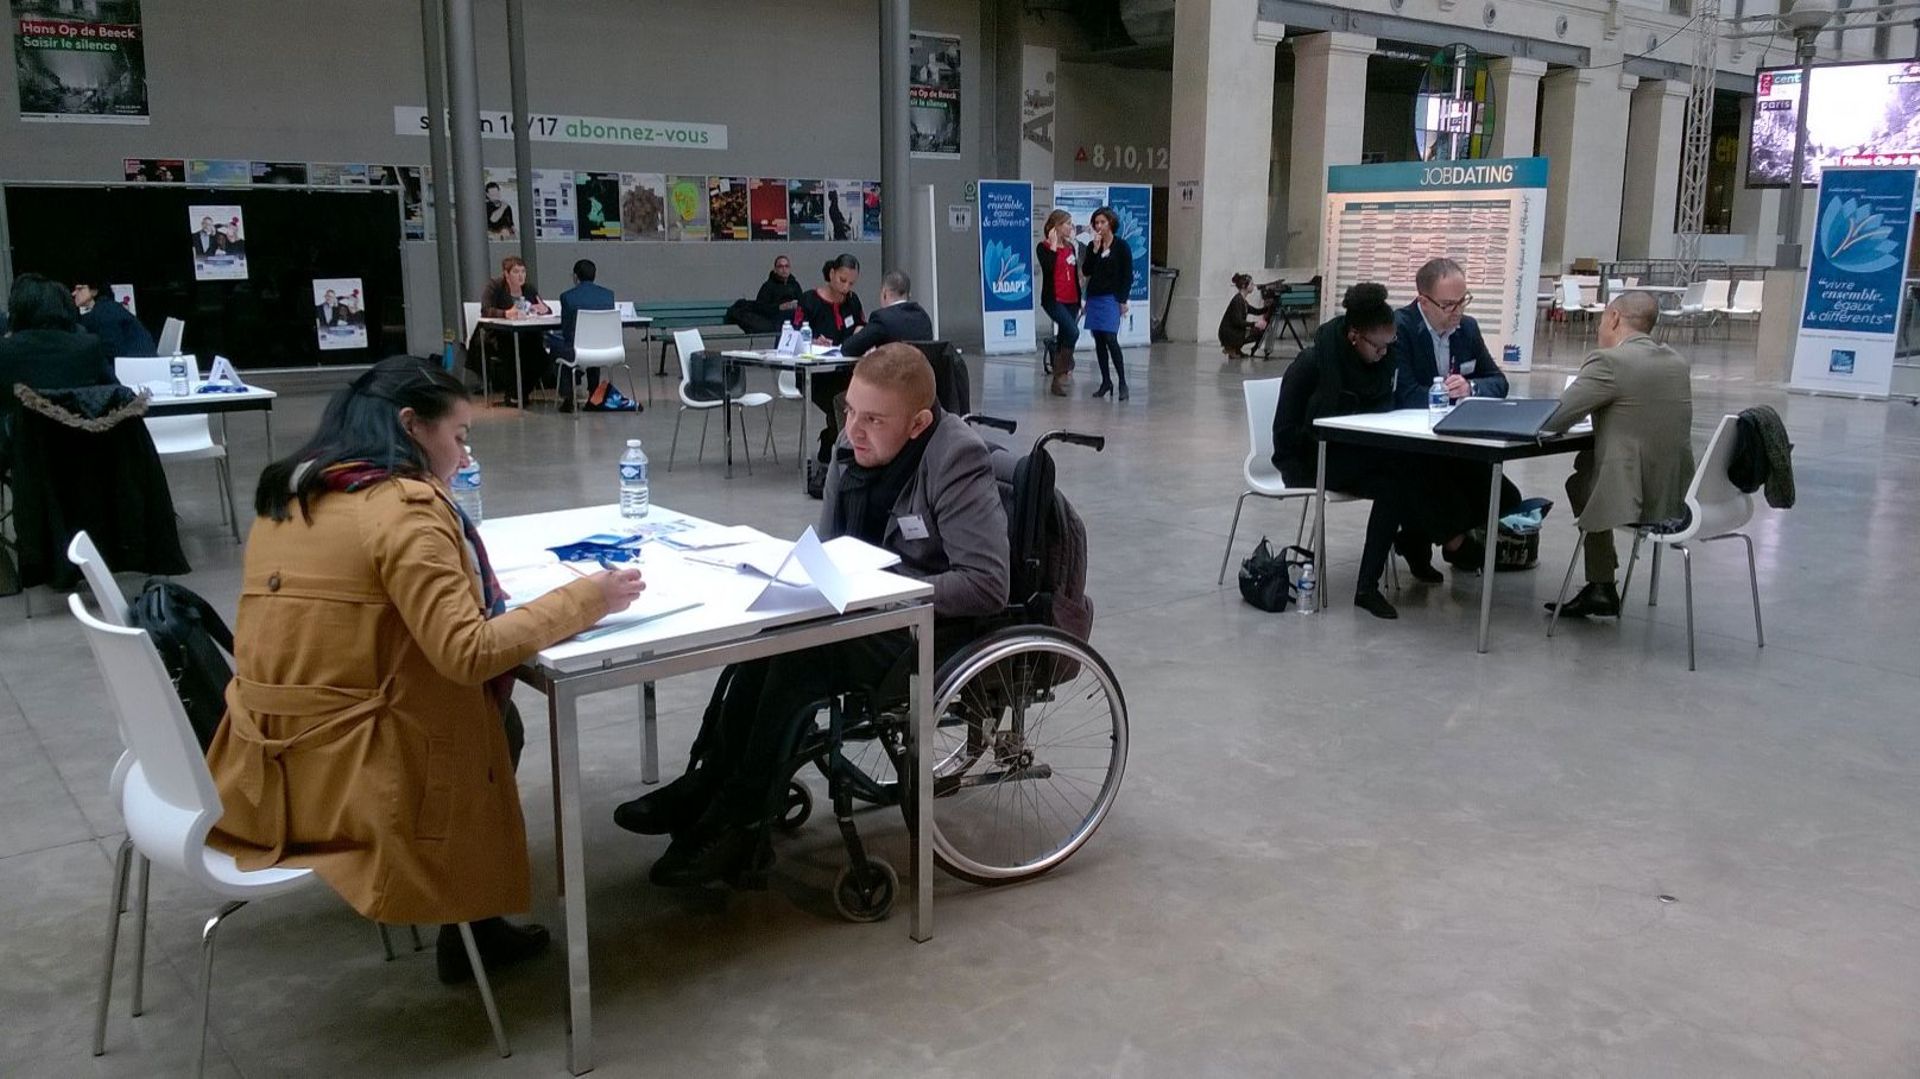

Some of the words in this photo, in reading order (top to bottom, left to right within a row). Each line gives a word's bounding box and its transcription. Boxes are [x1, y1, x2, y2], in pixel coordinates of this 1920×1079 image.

[22, 22, 56, 35] Hans
[59, 24, 78, 37] Op
[81, 25, 96, 37] de
[99, 26, 136, 39] Beeck
[23, 36, 58, 48] Saisir
[62, 38, 72, 49] le
[75, 39, 117, 51] silence
[918, 88, 929, 99] Op
[1761, 101, 1790, 111] paris
[565, 120, 709, 144] abonnez-vous
[1420, 165, 1513, 186] JOBDATING
[1821, 287, 1884, 303] ensemble,
[1833, 299, 1875, 313] égaux
[1806, 310, 1817, 321] &
